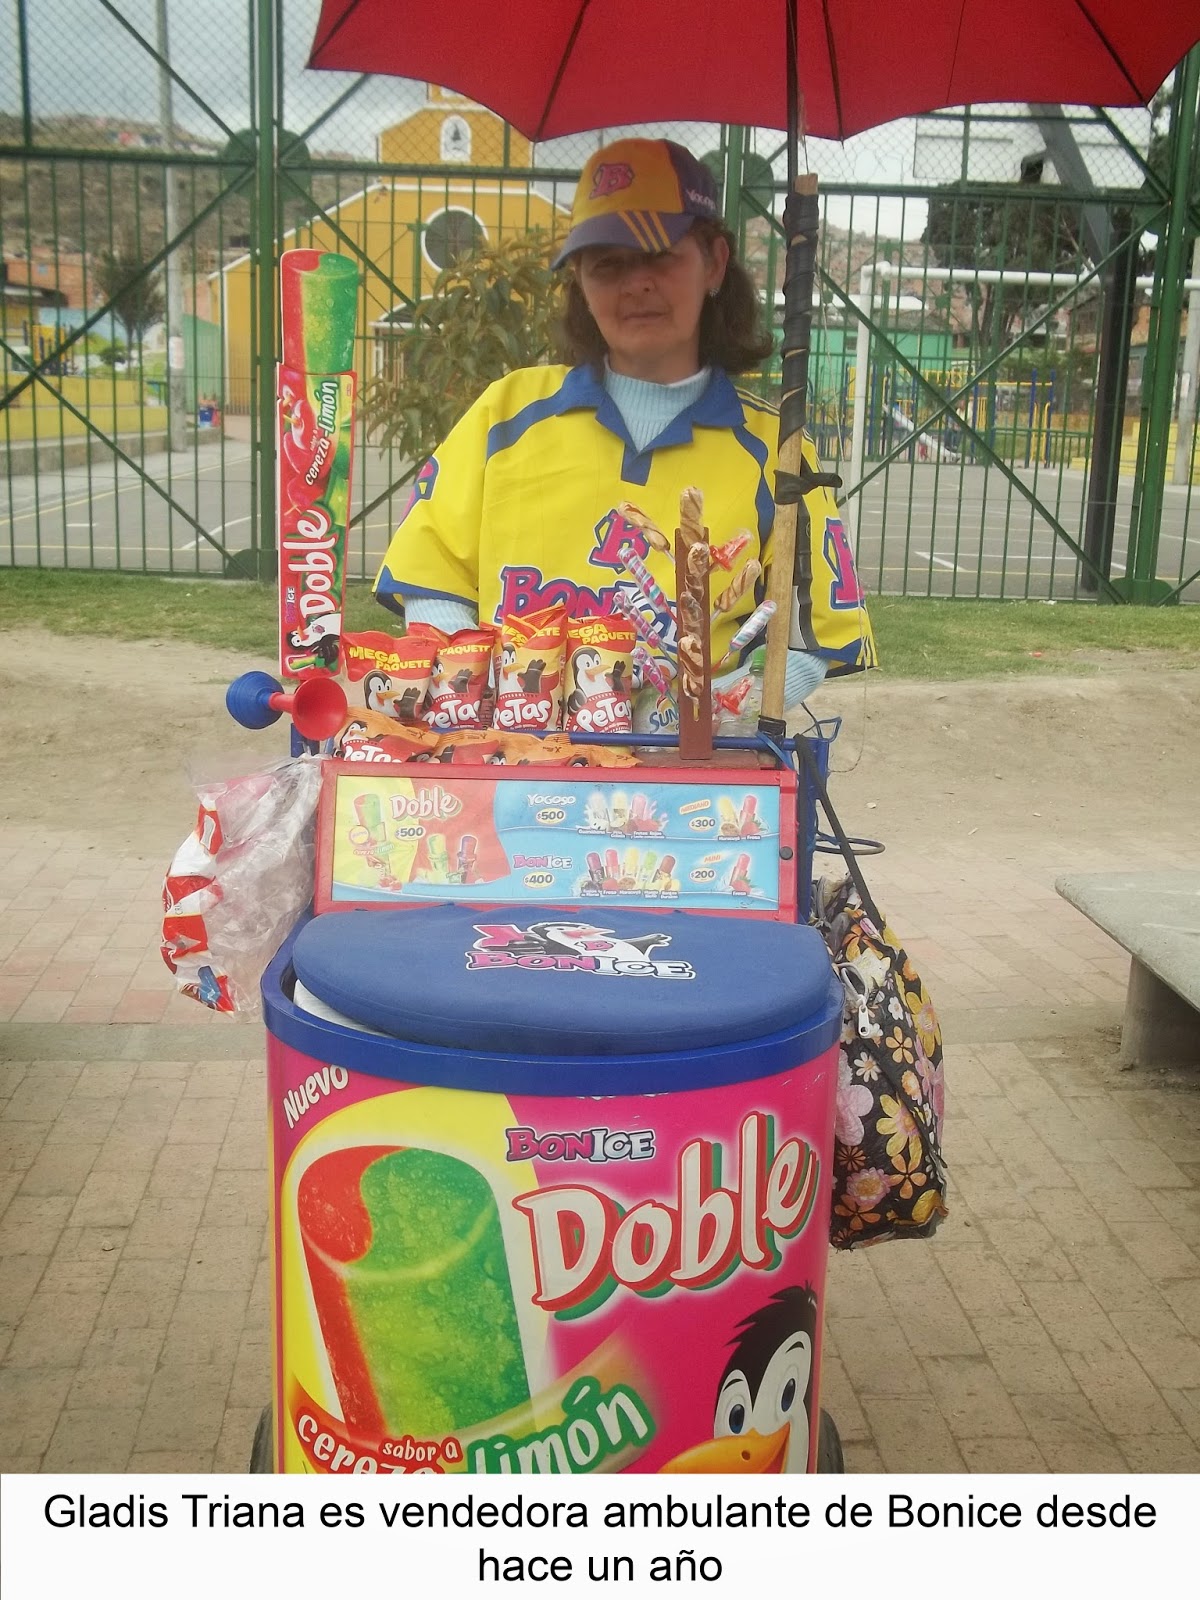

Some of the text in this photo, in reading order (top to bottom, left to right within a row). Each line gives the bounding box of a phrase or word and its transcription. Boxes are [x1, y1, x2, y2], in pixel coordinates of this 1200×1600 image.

[282, 508, 337, 619] Doble
[567, 623, 609, 639] EGA
[581, 633, 636, 645] PAQUETE
[349, 646, 401, 664] MEGA
[375, 660, 431, 672] PAQUETE
[390, 786, 460, 820] Doble
[537, 810, 565, 821] $500
[691, 818, 716, 828] $300
[395, 826, 425, 838] $500
[524, 873, 553, 885] $400
[690, 869, 715, 879] $200
[512, 1111, 818, 1314] Doble
[382, 1441, 459, 1462] sabor a
